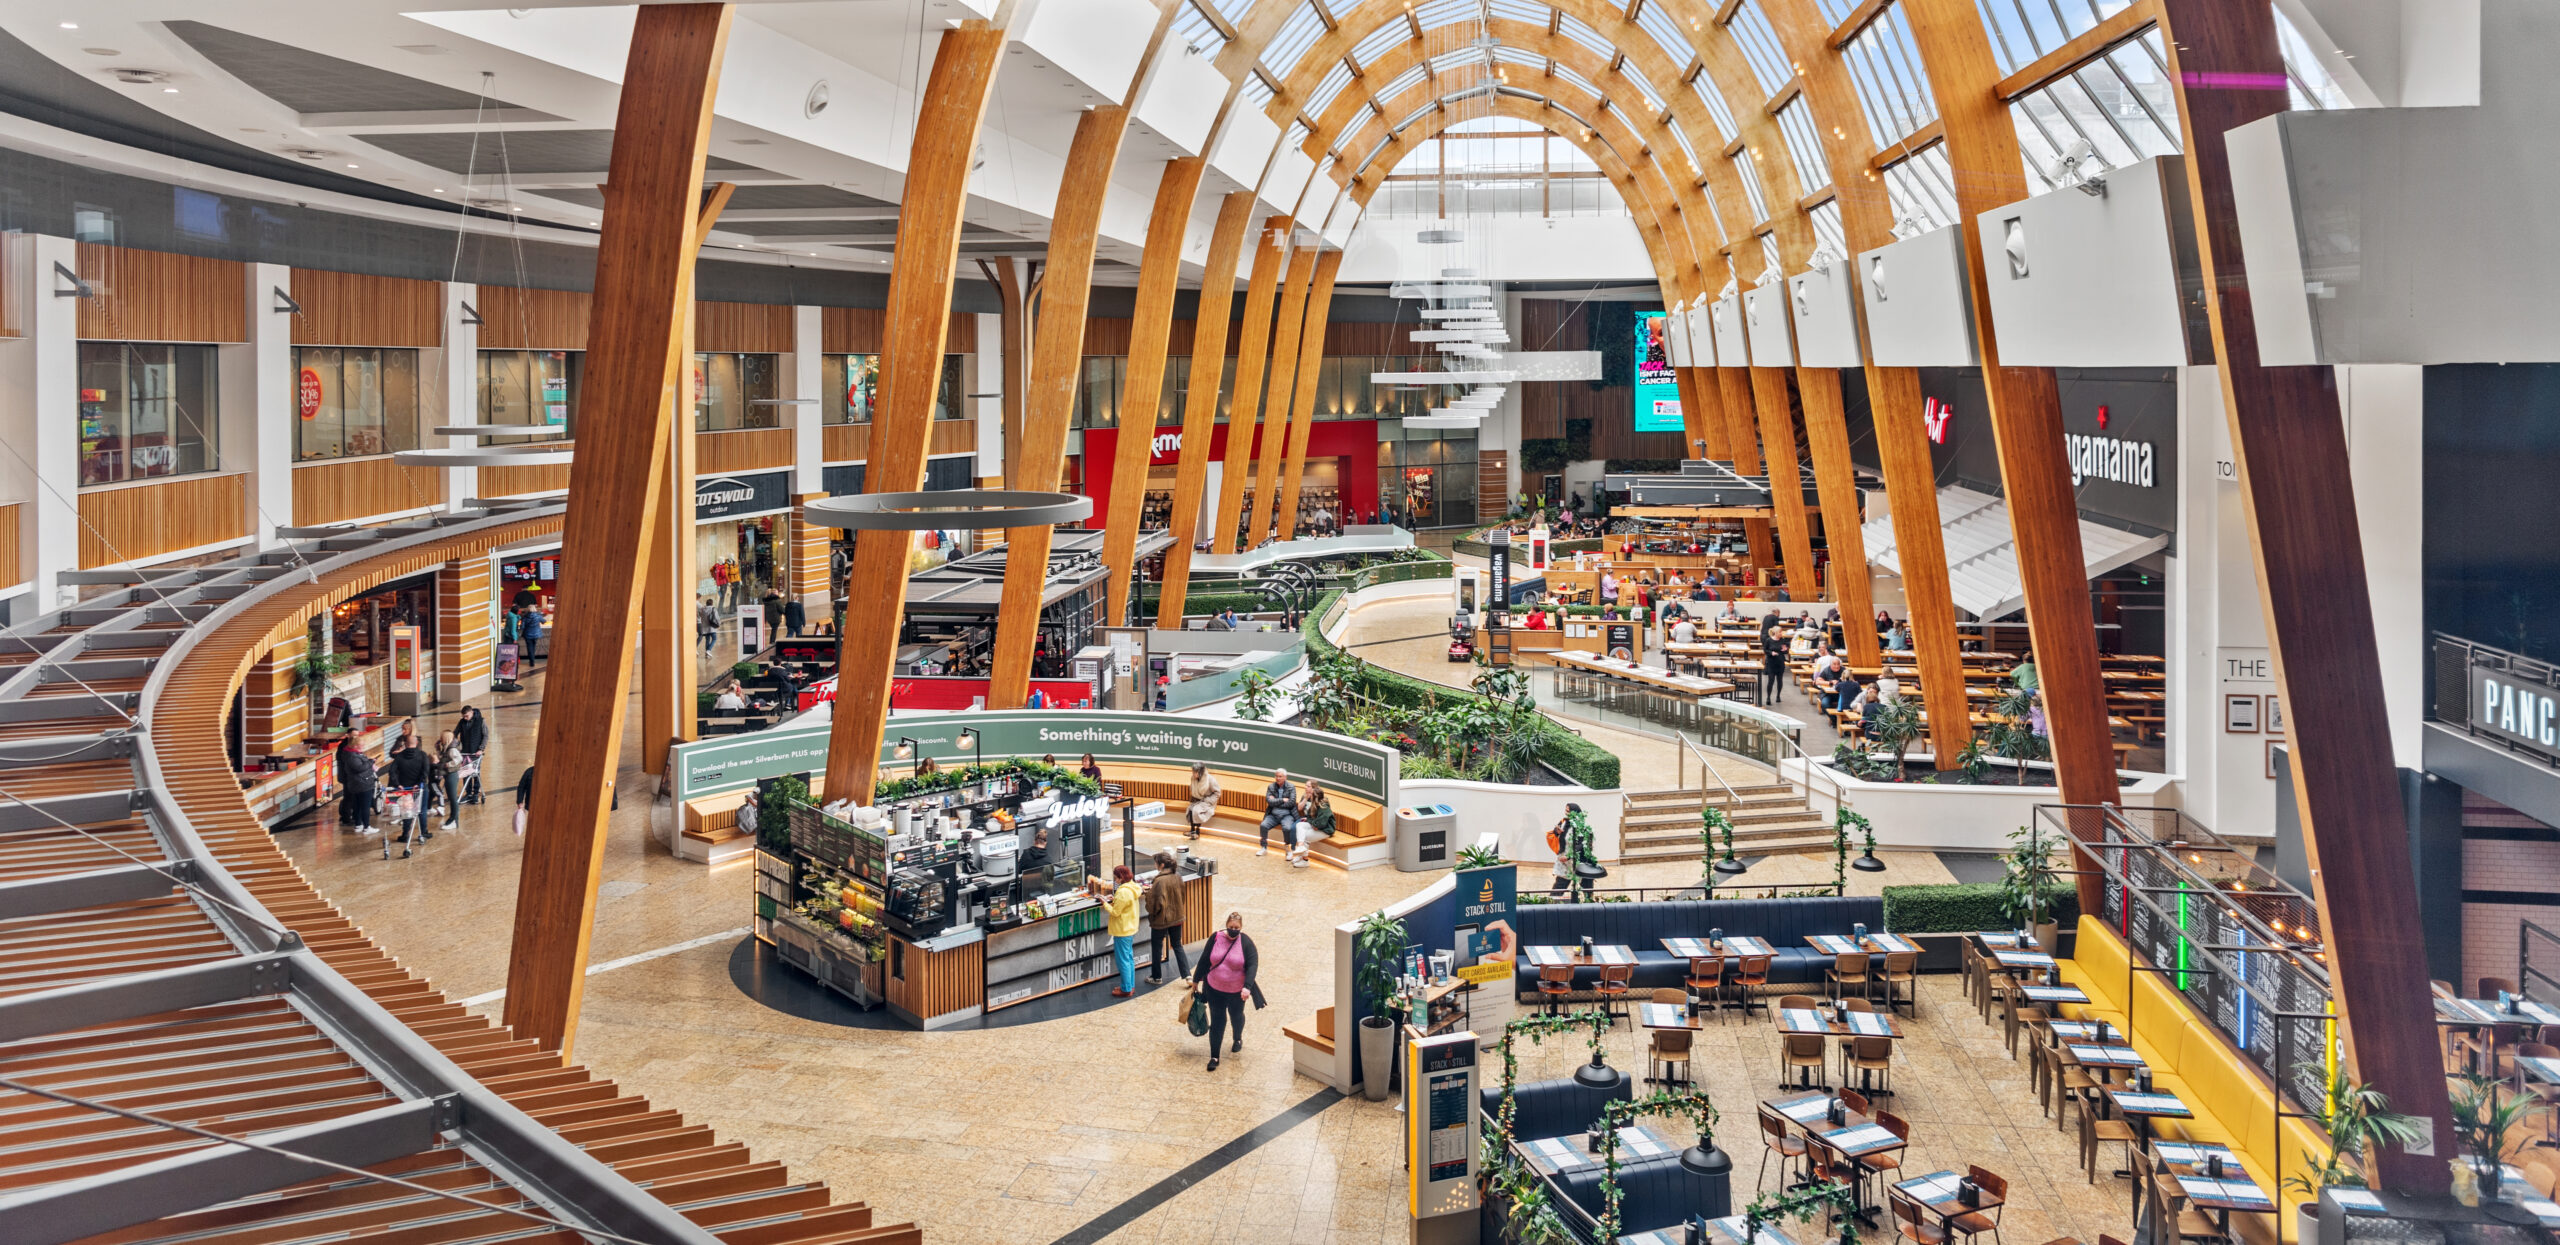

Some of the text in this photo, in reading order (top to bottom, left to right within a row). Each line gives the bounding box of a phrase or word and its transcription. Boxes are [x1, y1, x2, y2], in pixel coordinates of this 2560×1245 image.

[1639, 361, 1665, 371] JACK
[1640, 377, 1671, 385] CANCER
[1924, 396, 1953, 445] Hut
[2065, 433, 2154, 488] gamama
[695, 488, 754, 507] COTSWOLD
[710, 506, 728, 514] outdoor
[1493, 553, 1503, 602] wagamama
[2227, 659, 2266, 677] THE
[1039, 727, 1249, 753] Something's waiting for you
[692, 762, 726, 774] Download
[727, 760, 738, 768] the
[755, 753, 790, 763] Silverburn
[791, 749, 808, 758] PLUS
[810, 749, 823, 757] app
[1323, 757, 1376, 781] SILVERBURN
[1045, 795, 1110, 828] Juicy
[1465, 904, 1485, 917] STACK
[1489, 901, 1506, 914] STILL
[1058, 906, 1101, 939] HEALTH
[1065, 934, 1095, 962] IS AN
[1049, 962, 1084, 991] INSIDE
[1088, 955, 1111, 980] JOB
[1486, 964, 1510, 975] AVAILABLE
[1430, 1060, 1447, 1071] STACK
[1452, 1057, 1466, 1067] STILL
